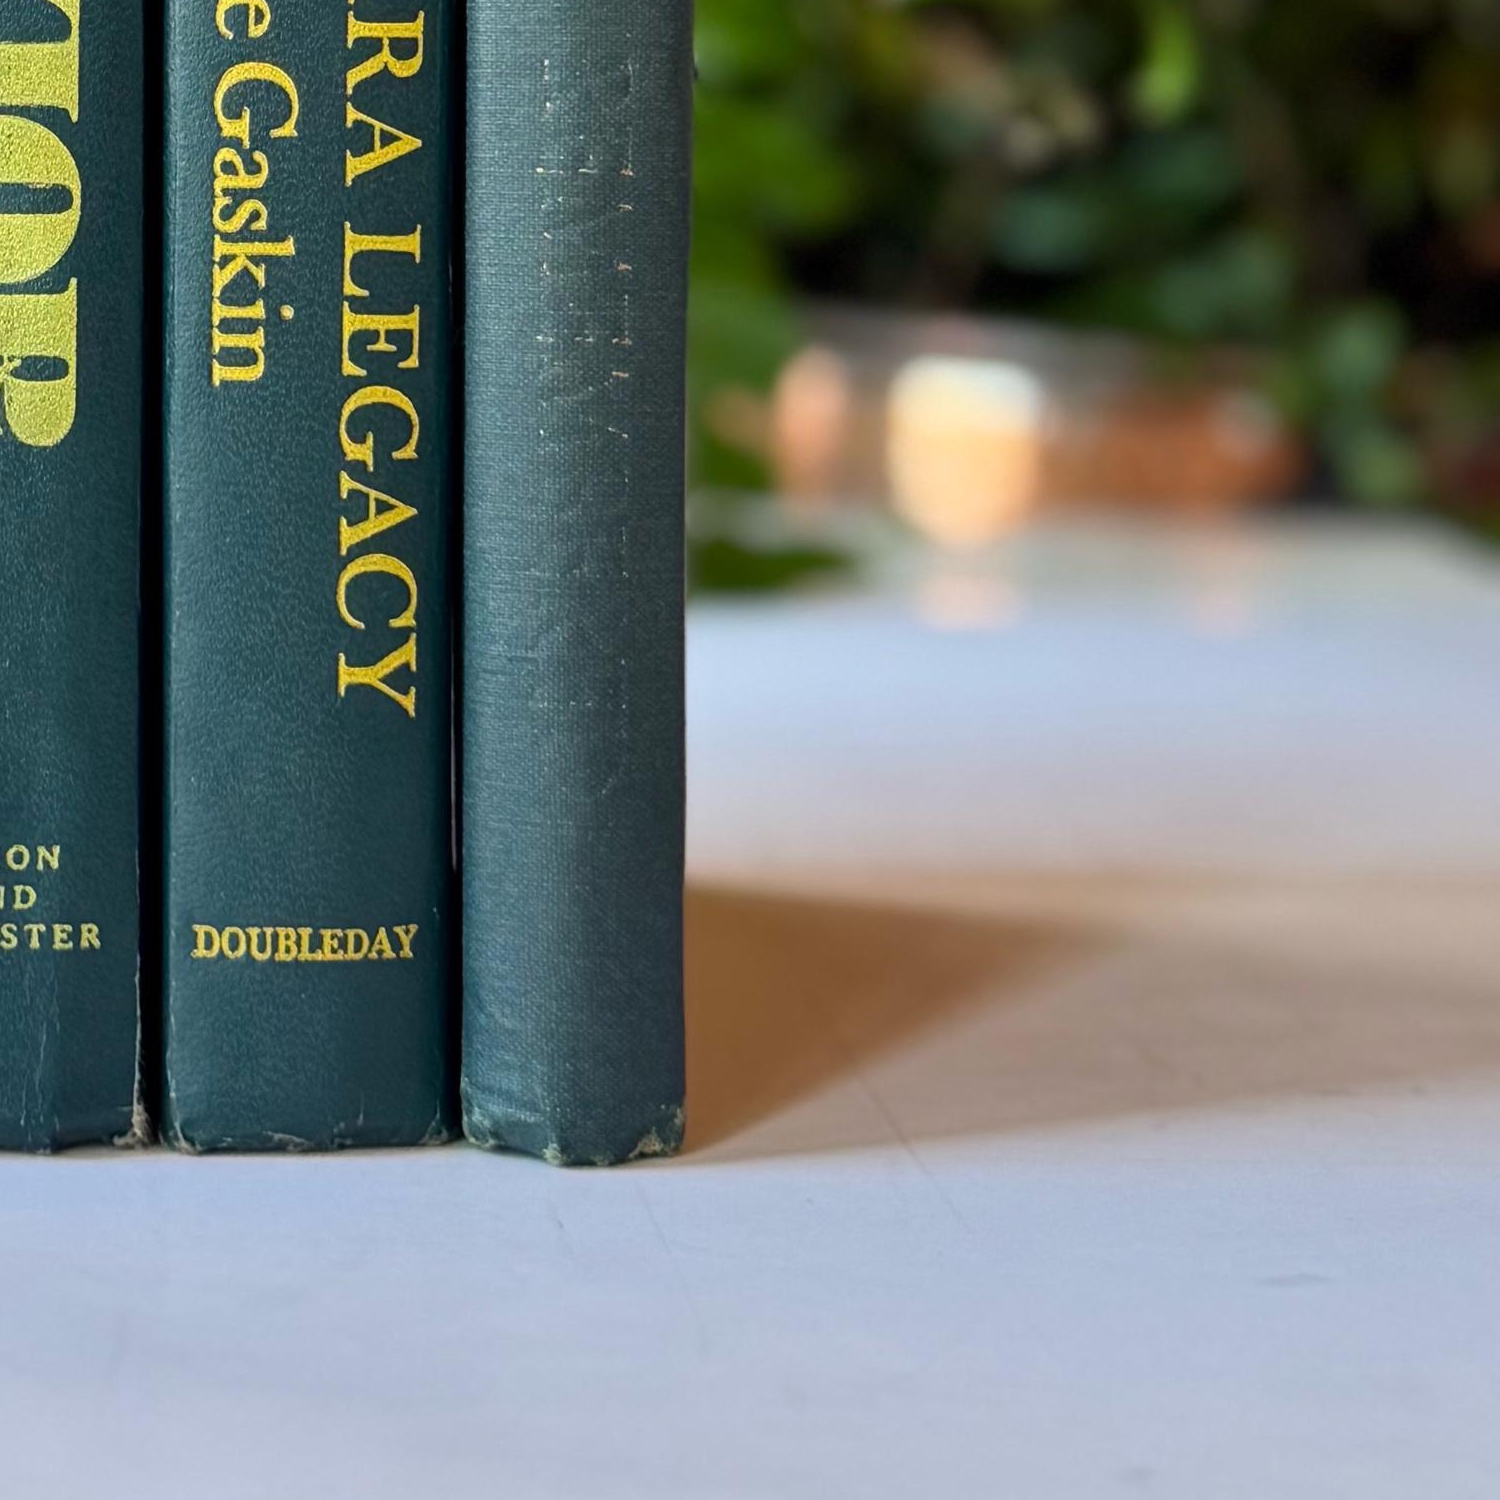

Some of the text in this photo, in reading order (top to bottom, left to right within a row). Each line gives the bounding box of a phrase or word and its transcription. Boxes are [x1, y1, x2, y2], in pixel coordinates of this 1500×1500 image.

[209, 61, 299, 386] Gaskin
[335, 220, 422, 718] LEGACY
[190, 922, 420, 962] DOUBLEDAY
